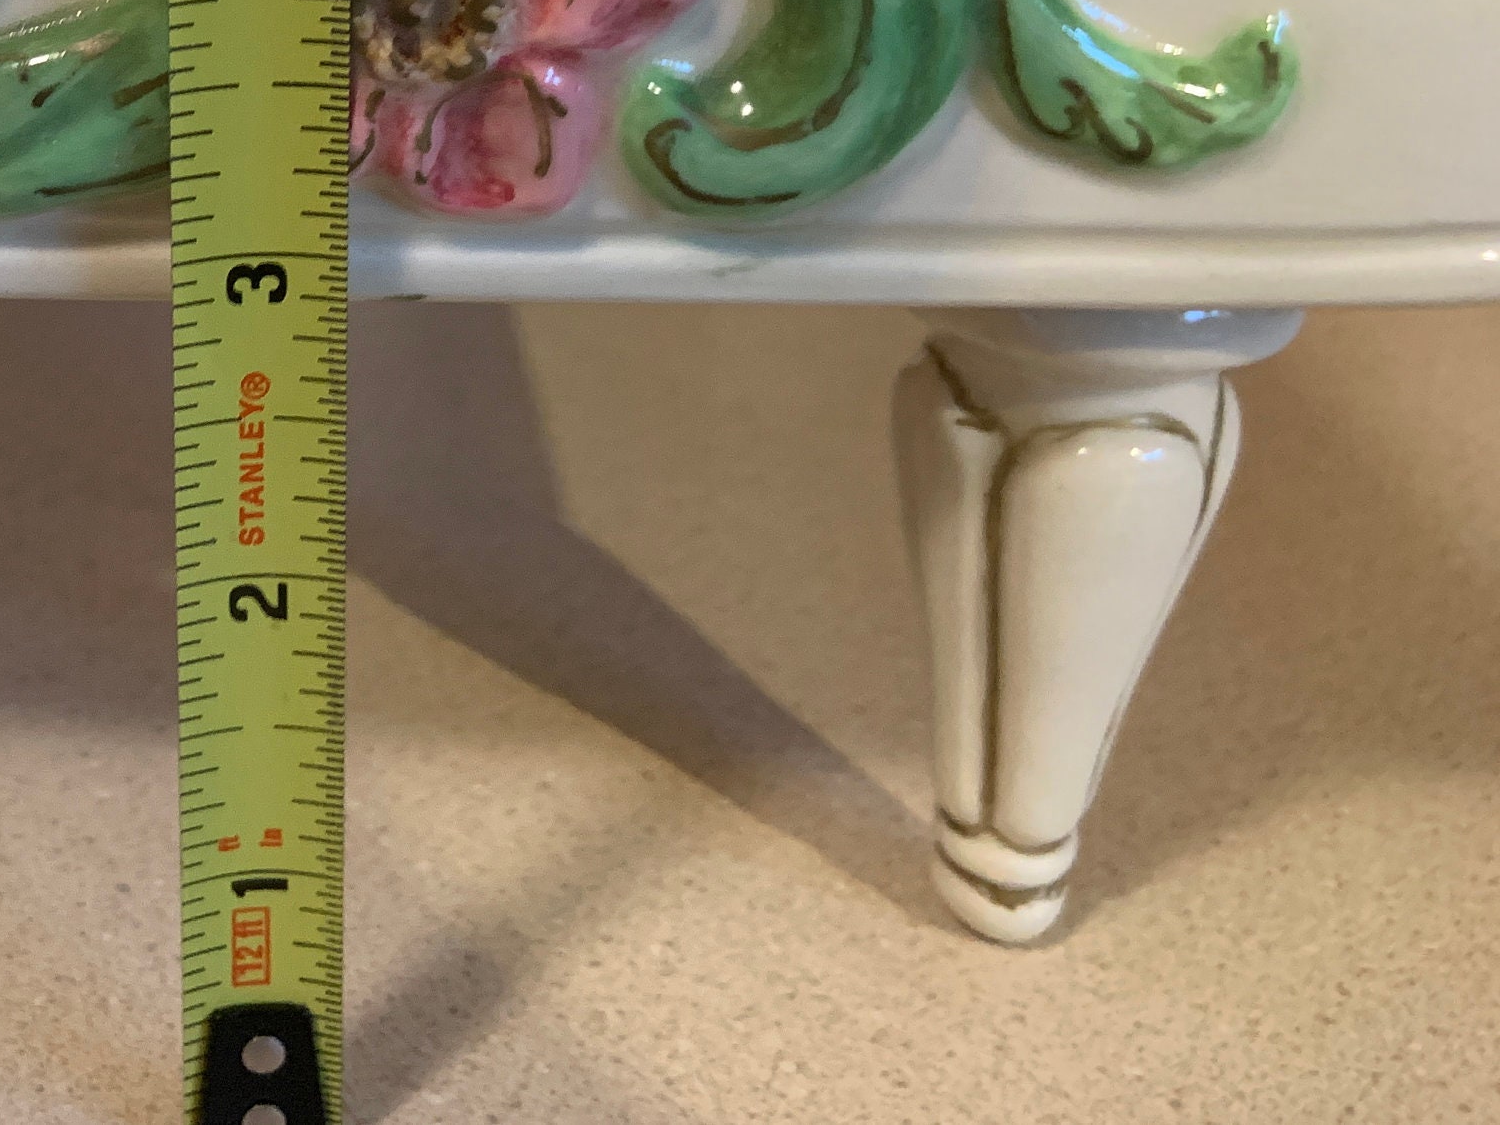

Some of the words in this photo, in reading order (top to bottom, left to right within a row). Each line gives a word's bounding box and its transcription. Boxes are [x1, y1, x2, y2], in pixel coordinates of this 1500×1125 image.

[226, 262, 288, 305] 3
[229, 582, 288, 622] 2
[231, 878, 288, 898] 1
[234, 945, 264, 977] 12
